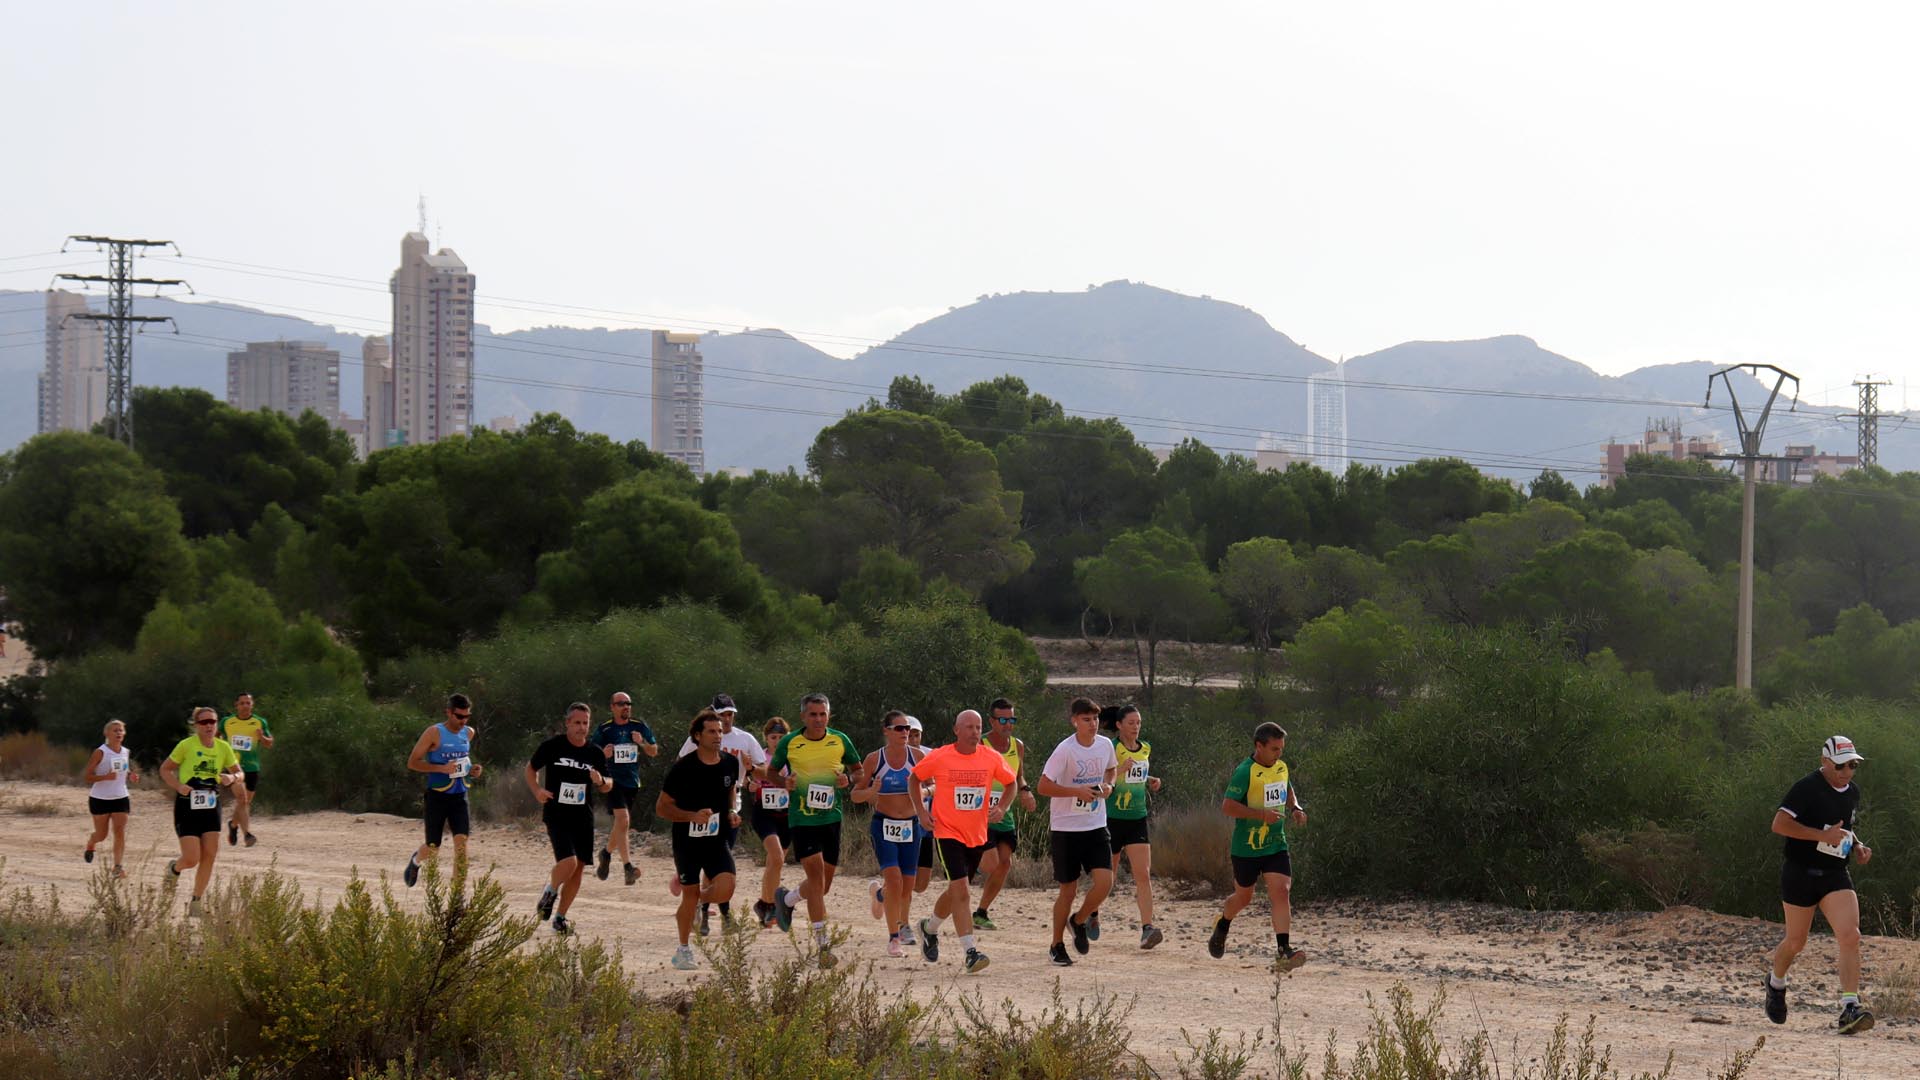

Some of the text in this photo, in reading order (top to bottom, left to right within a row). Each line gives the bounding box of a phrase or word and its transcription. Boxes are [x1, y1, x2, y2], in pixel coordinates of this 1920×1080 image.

[616, 750, 630, 759] 134
[1127, 767, 1142, 778] 145
[563, 789, 575, 799] 44
[765, 794, 775, 804] 51
[810, 790, 828, 803] 140
[956, 793, 975, 805] 137
[1265, 789, 1279, 801] 143
[989, 796, 1000, 806] 13
[885, 824, 901, 837] 132
